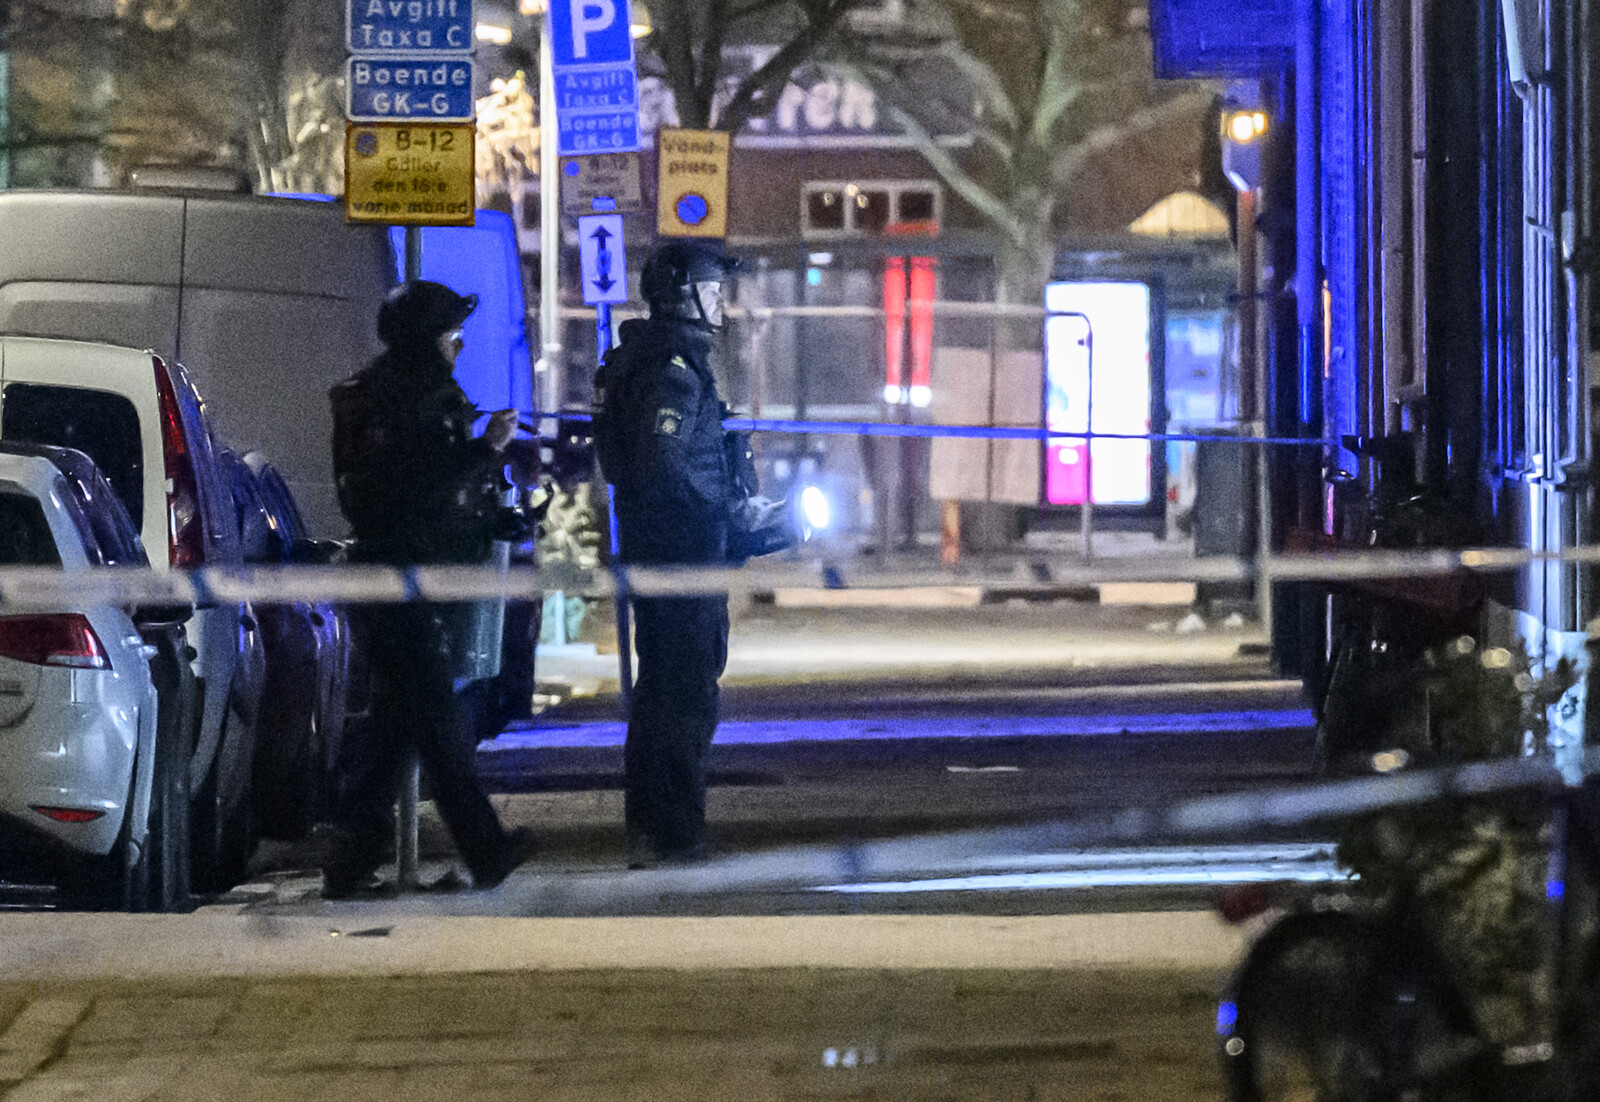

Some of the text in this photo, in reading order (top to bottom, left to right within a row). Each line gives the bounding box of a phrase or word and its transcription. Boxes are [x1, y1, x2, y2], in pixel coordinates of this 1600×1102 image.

[361, 24, 462, 47] Taxa C
[569, 0, 615, 58] P
[355, 63, 467, 86] Boende
[373, 92, 450, 114] GK-G
[396, 130, 455, 152] 8-12
